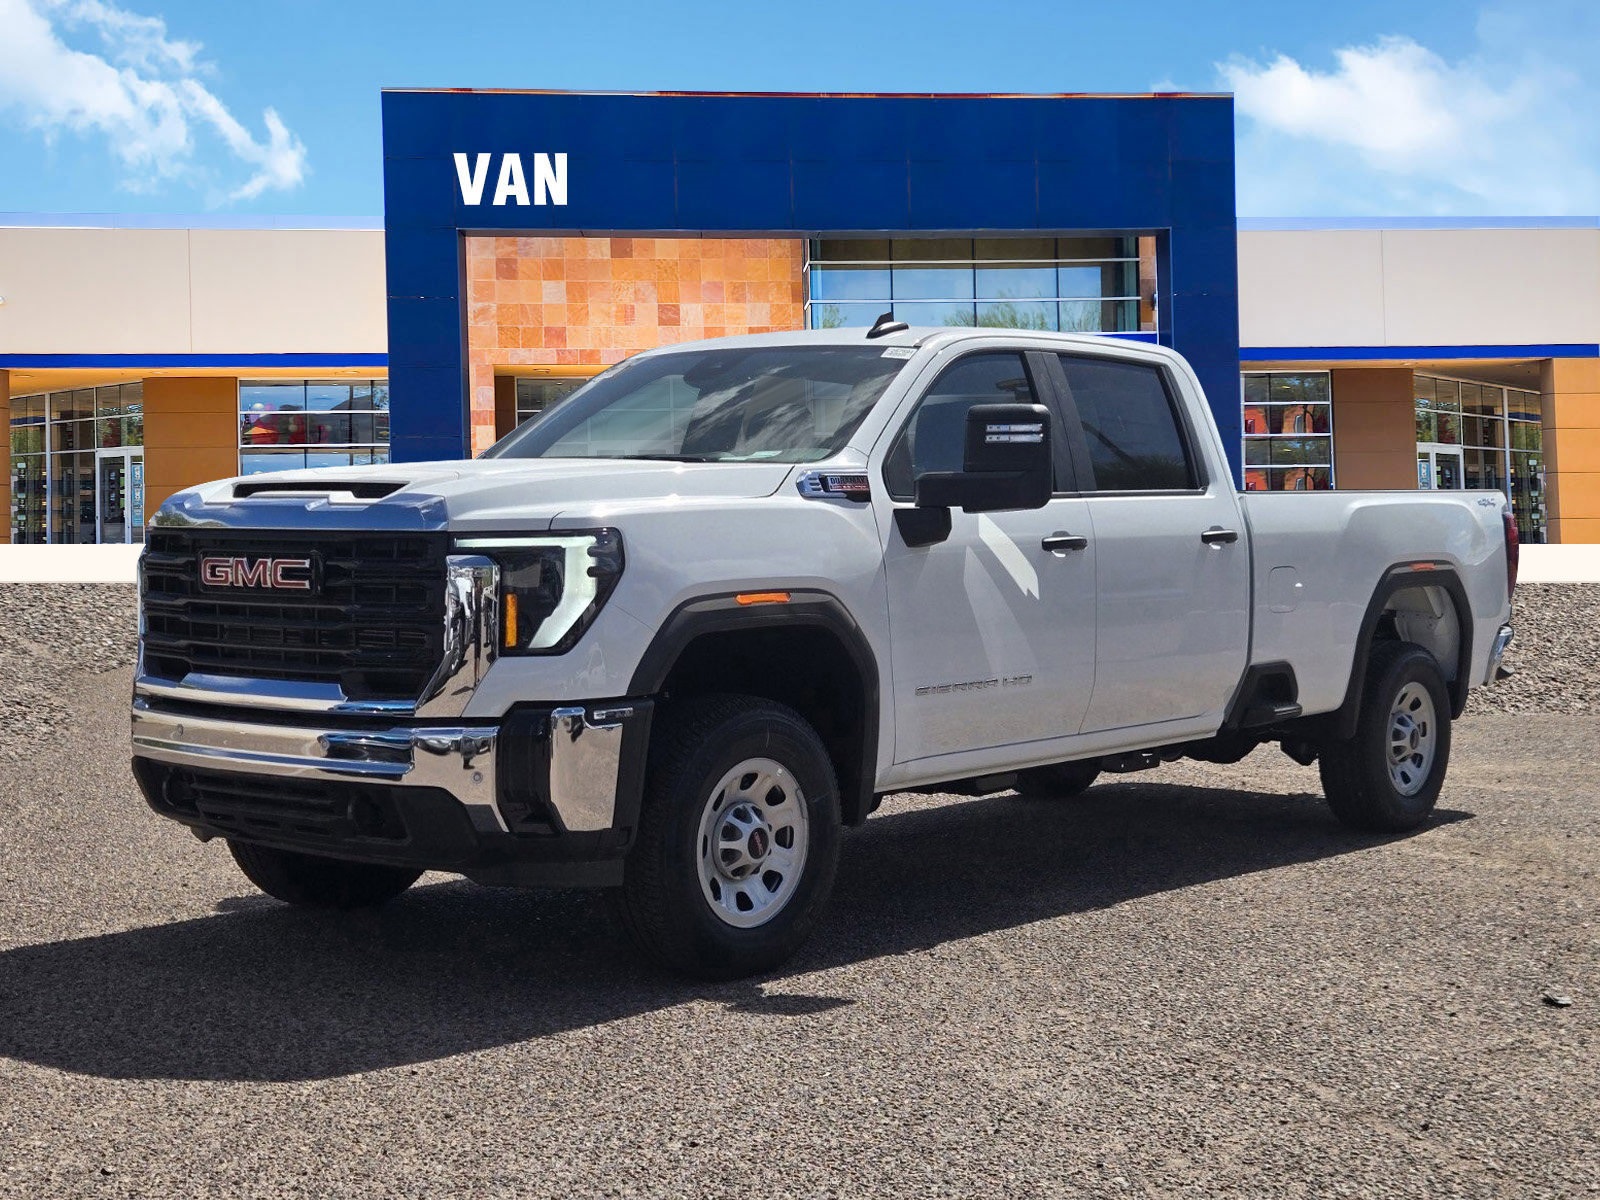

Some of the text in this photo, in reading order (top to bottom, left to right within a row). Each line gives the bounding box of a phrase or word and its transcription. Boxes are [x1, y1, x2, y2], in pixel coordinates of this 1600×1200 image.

[453, 152, 568, 206] VAN
[202, 557, 311, 589] GMC
[915, 675, 1033, 696] SIERRA HD
